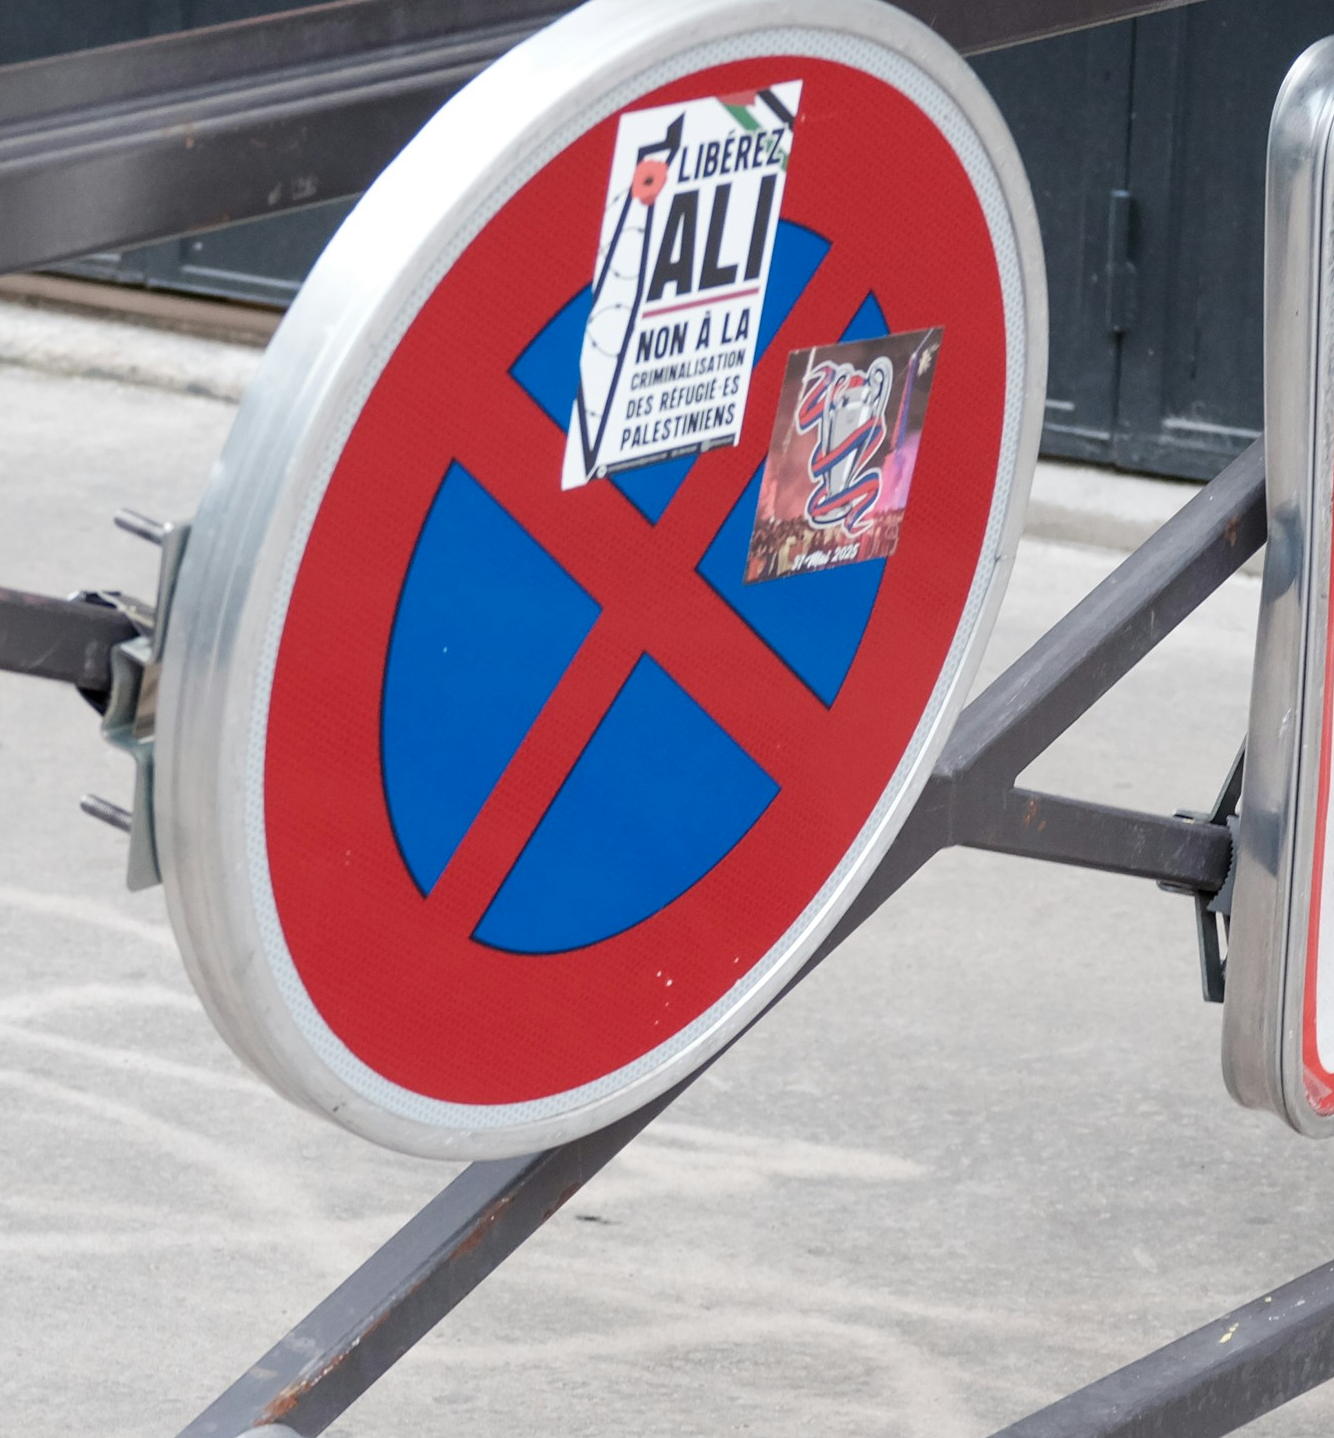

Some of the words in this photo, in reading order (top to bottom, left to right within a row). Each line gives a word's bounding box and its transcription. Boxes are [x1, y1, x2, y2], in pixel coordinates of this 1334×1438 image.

[678, 129, 785, 183] LIBÉREZ
[646, 173, 777, 303] ALI
[635, 322, 688, 364] NON
[695, 310, 711, 351] À
[721, 307, 751, 346] LA
[630, 348, 746, 391] CRIMINALISATION
[620, 403, 736, 451] PALESTINIENS
[626, 395, 654, 421] DES
